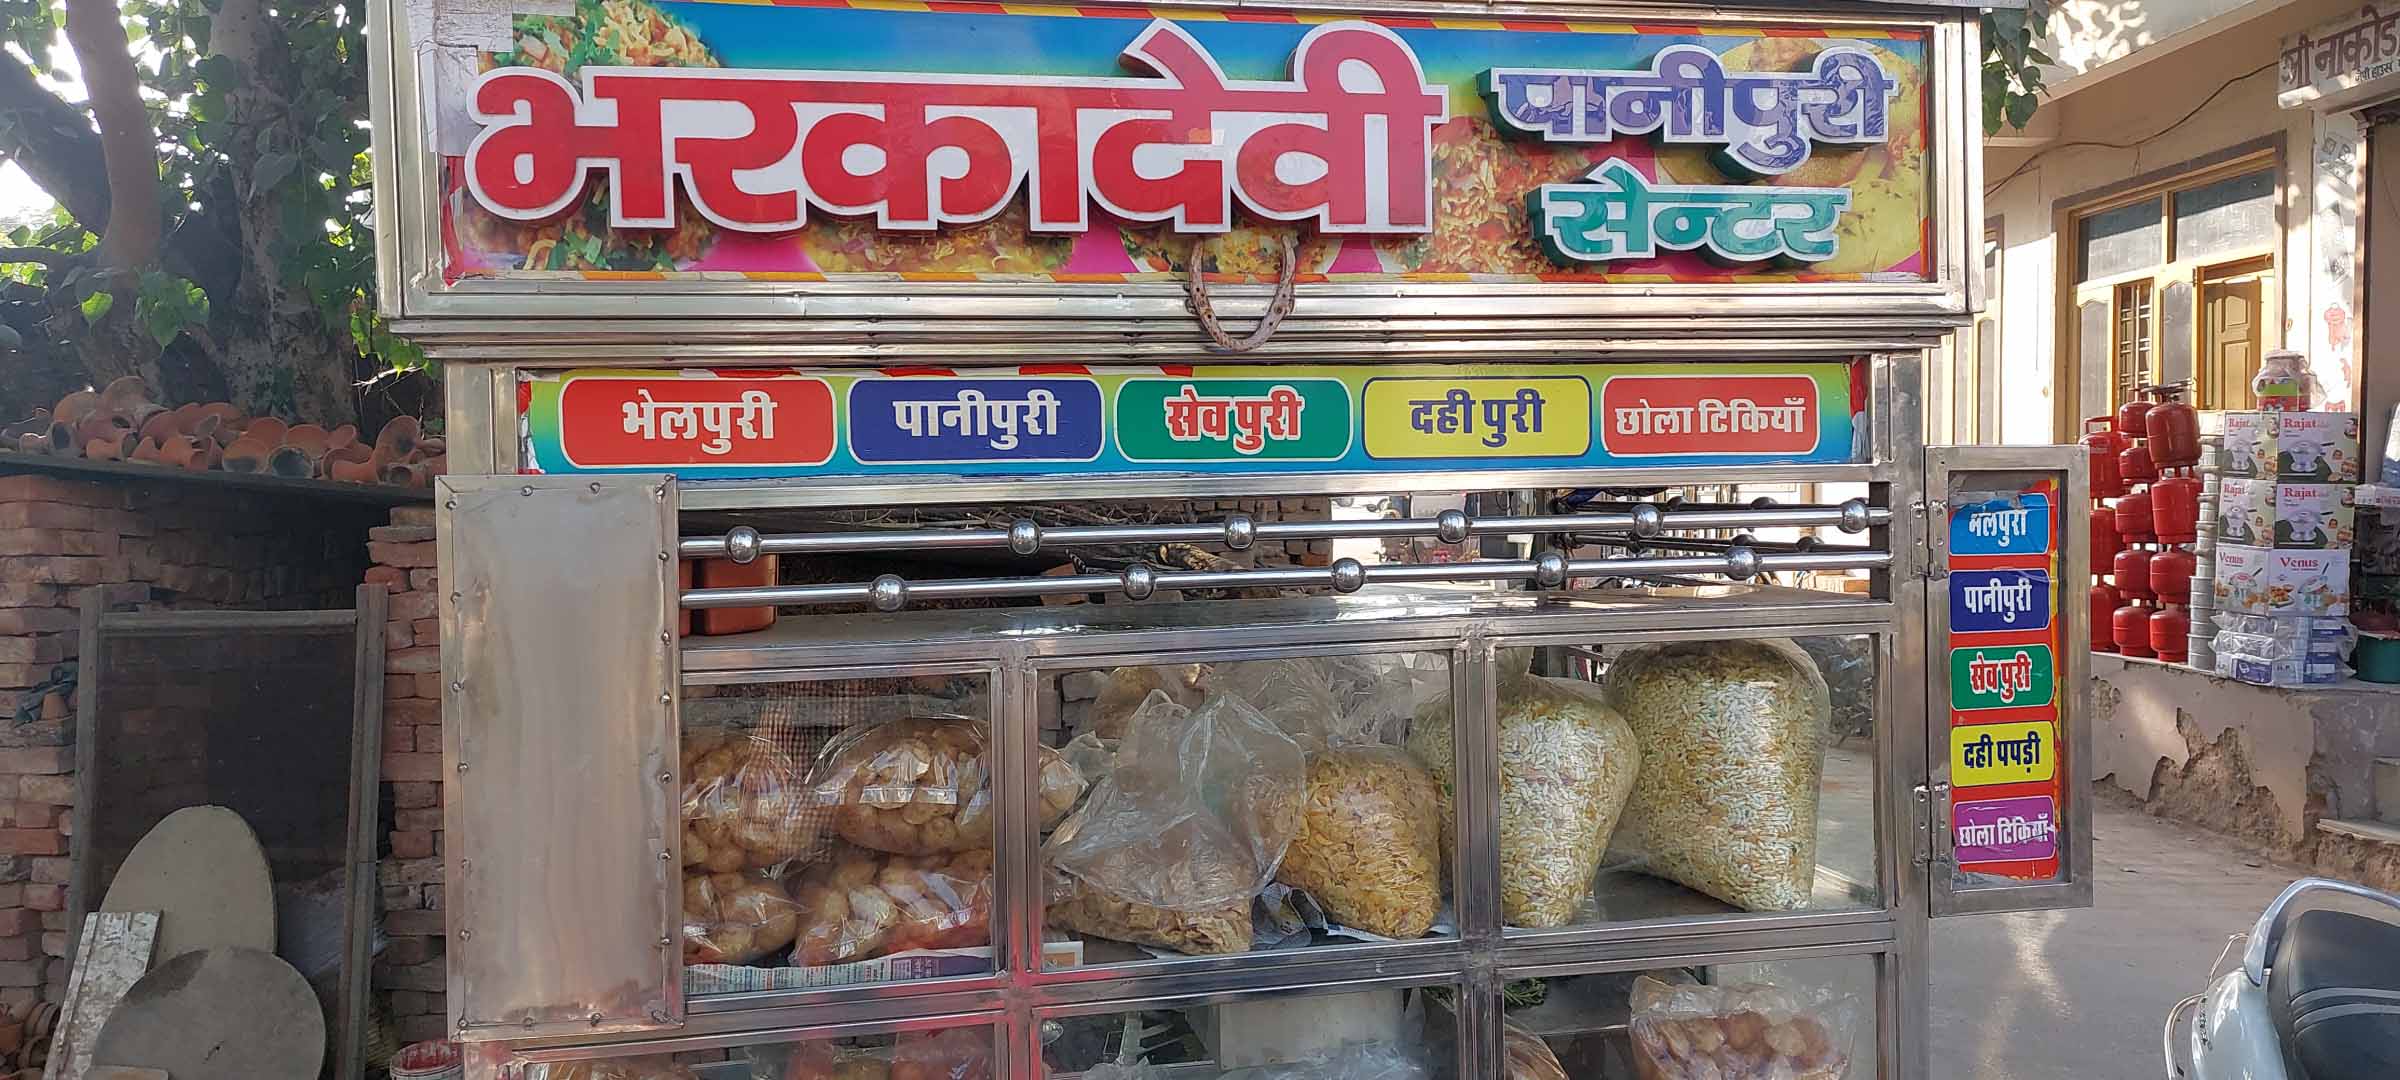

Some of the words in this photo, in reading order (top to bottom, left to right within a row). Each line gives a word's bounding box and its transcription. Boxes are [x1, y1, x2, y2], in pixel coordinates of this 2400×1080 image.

[468, 20, 1446, 231] भरकादेवी
[1494, 46, 1896, 172] पानीपुरी
[622, 389, 778, 454] भेलपुरी
[893, 389, 1061, 450] पानीपुरी
[1164, 386, 1234, 441] सेव
[1232, 385, 1304, 454] पुरी
[1409, 391, 1476, 434] दही
[1482, 391, 1544, 448] पुरी
[1615, 402, 1694, 434] छोला
[1700, 397, 1806, 434] टिकियाँ
[2228, 418, 2249, 430] Rajat
[2283, 418, 2317, 431] Rajat
[2223, 483, 2245, 496] Rajat
[2283, 487, 2317, 501] Rajat
[2219, 551, 2244, 565] Venus
[2279, 557, 2319, 568] Venus
[1963, 577, 2033, 623] पानीपुरी
[1969, 651, 2000, 695] सेव
[1999, 651, 2032, 702] पुरी
[1963, 733, 1993, 769] दही
[1996, 730, 2041, 773] पपड़ी
[1959, 819, 1996, 848] छोला
